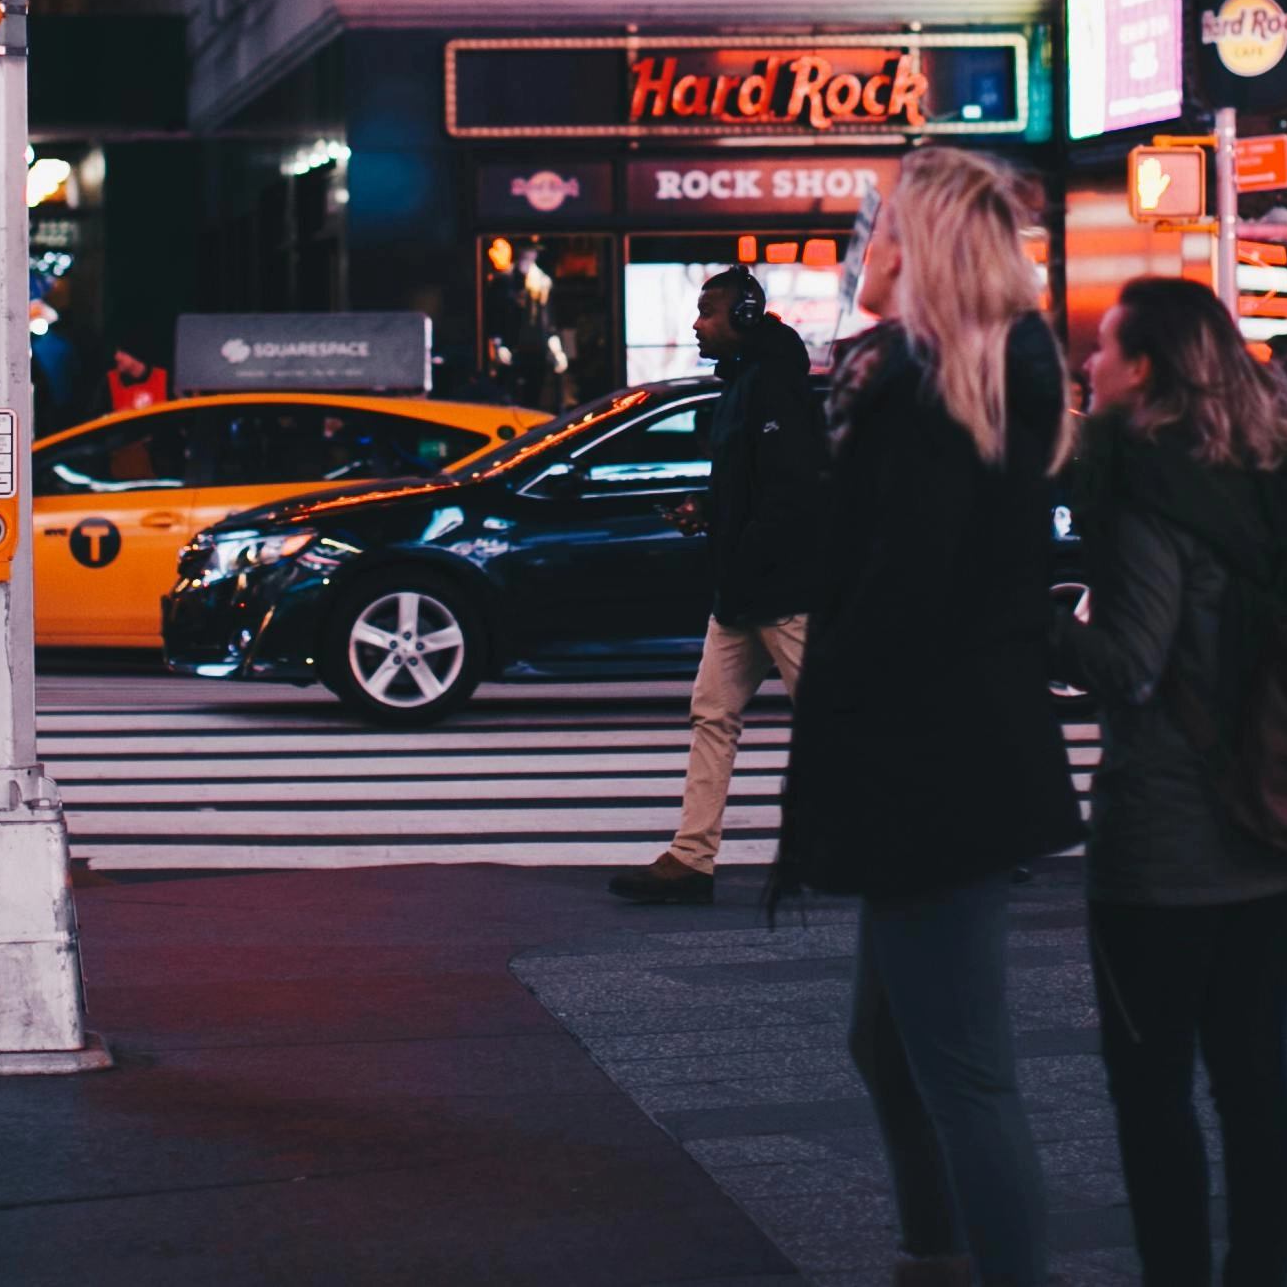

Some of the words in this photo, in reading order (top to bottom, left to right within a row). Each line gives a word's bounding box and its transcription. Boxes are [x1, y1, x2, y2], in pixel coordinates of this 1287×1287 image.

[1202, 10, 1245, 43] Hard
[630, 58, 779, 117] Hard
[787, 54, 929, 129] Rock
[656, 170, 762, 199] ROCK
[772, 169, 879, 199] SHOP
[254, 341, 369, 358] SQUARESPACE
[80, 526, 109, 562] T
